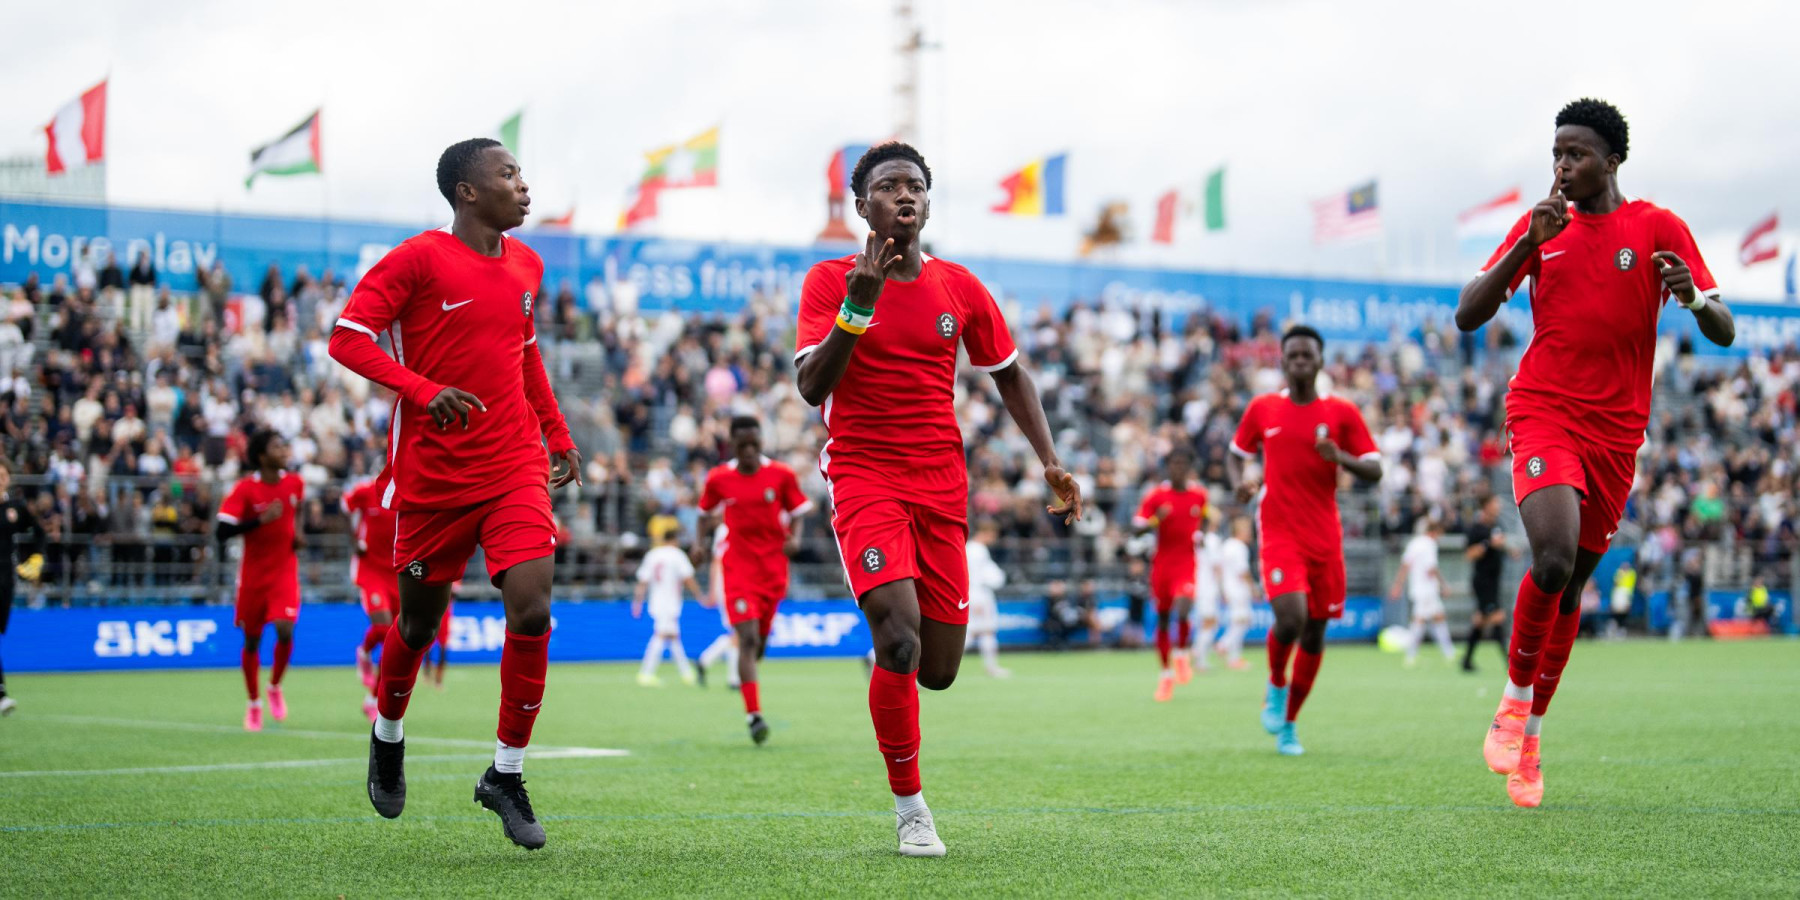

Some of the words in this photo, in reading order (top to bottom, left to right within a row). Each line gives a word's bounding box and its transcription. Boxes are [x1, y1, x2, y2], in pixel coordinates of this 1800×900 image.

[3, 223, 113, 271] More
[700, 259, 806, 299] fricti
[94, 619, 218, 657] SKF
